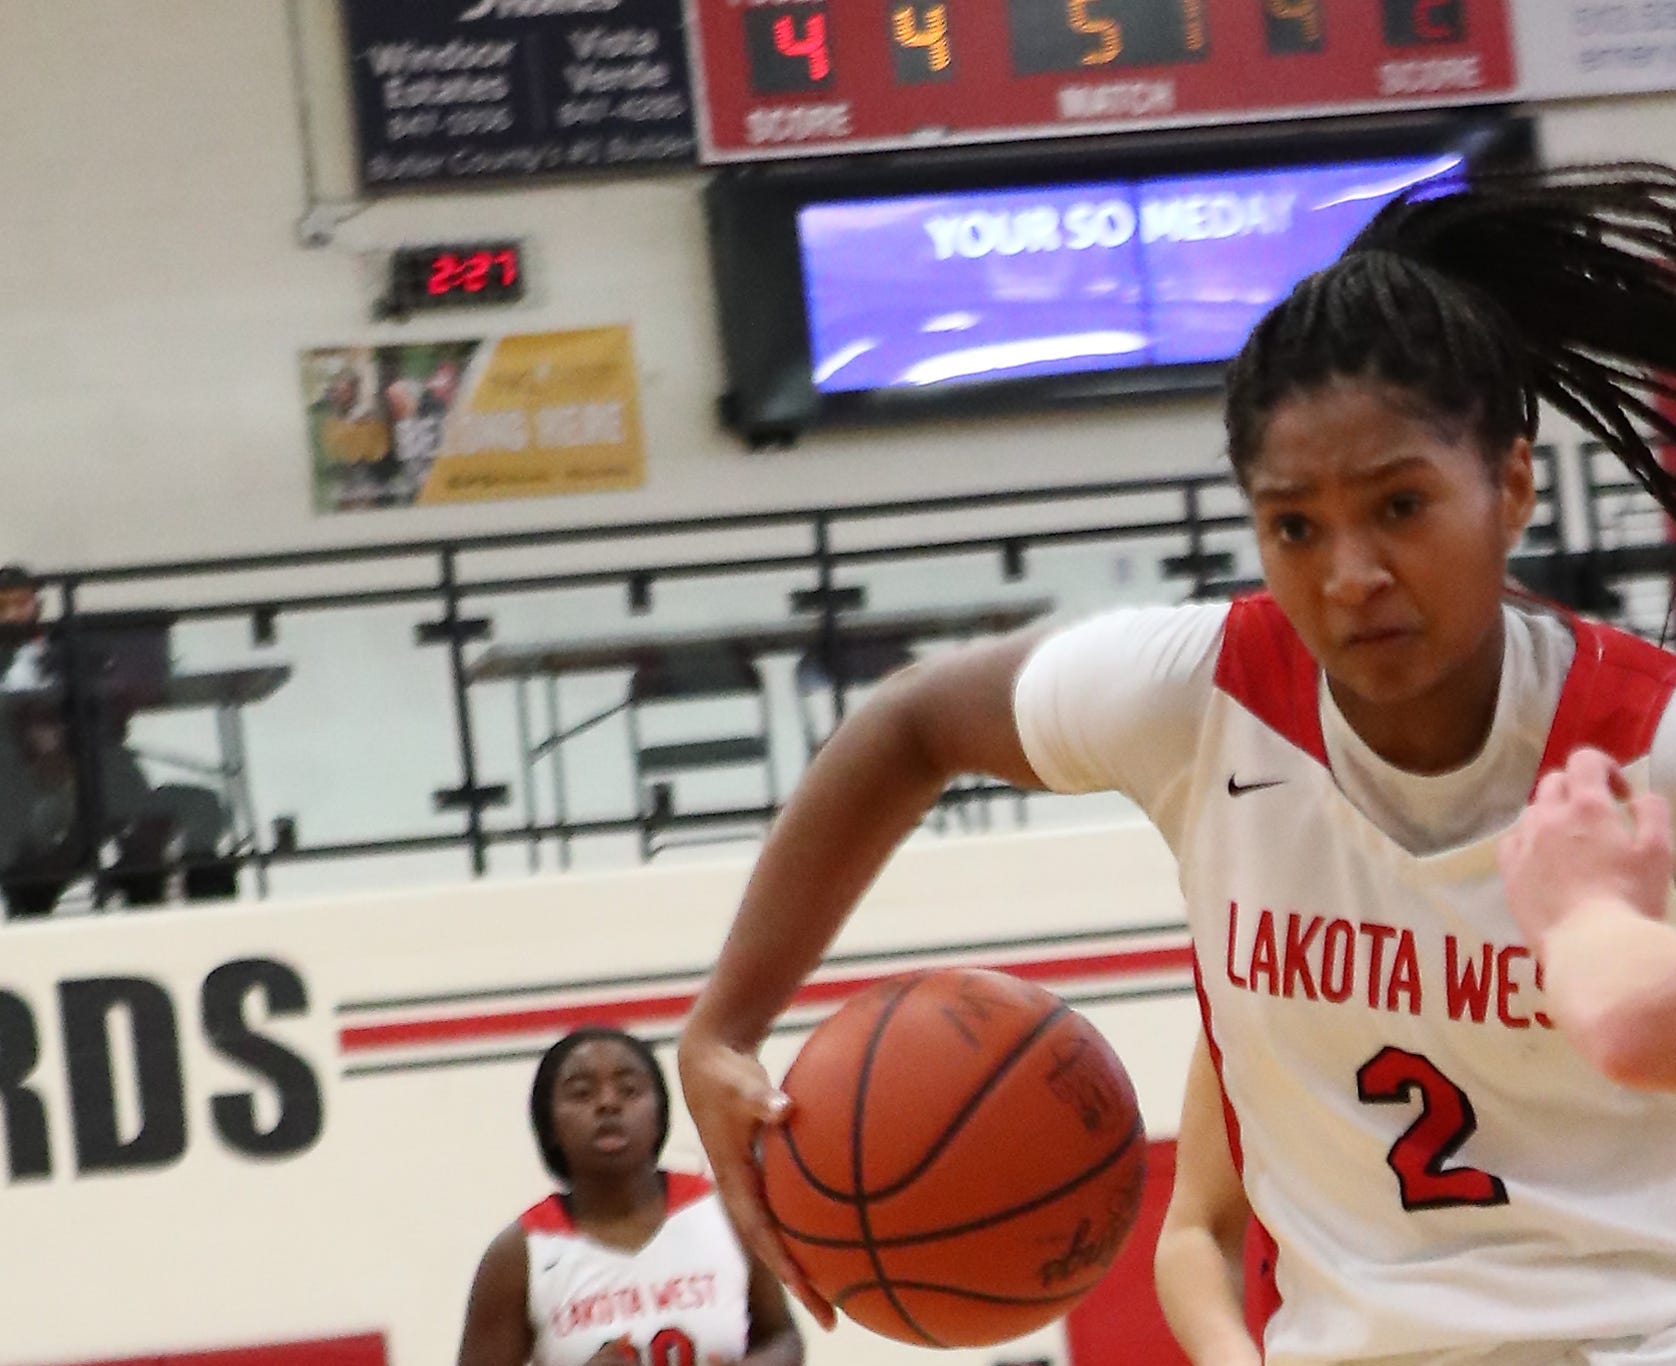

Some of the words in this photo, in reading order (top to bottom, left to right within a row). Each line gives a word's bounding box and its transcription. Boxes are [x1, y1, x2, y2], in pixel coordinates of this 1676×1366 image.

[368, 39, 517, 77] Windsor
[773, 12, 830, 81] 4
[893, 4, 951, 72] 4
[383, 73, 511, 110] Estates
[1057, 79, 1176, 118] MATCH
[1378, 55, 1482, 96] SCORE
[745, 102, 853, 145] SCORE
[924, 206, 1063, 260] YOUR
[1226, 901, 1423, 1016] LAKOTA
[1356, 1045, 1511, 1213] 2
[553, 1286, 642, 1337] LAKOTA
[653, 1273, 716, 1311] WEST
